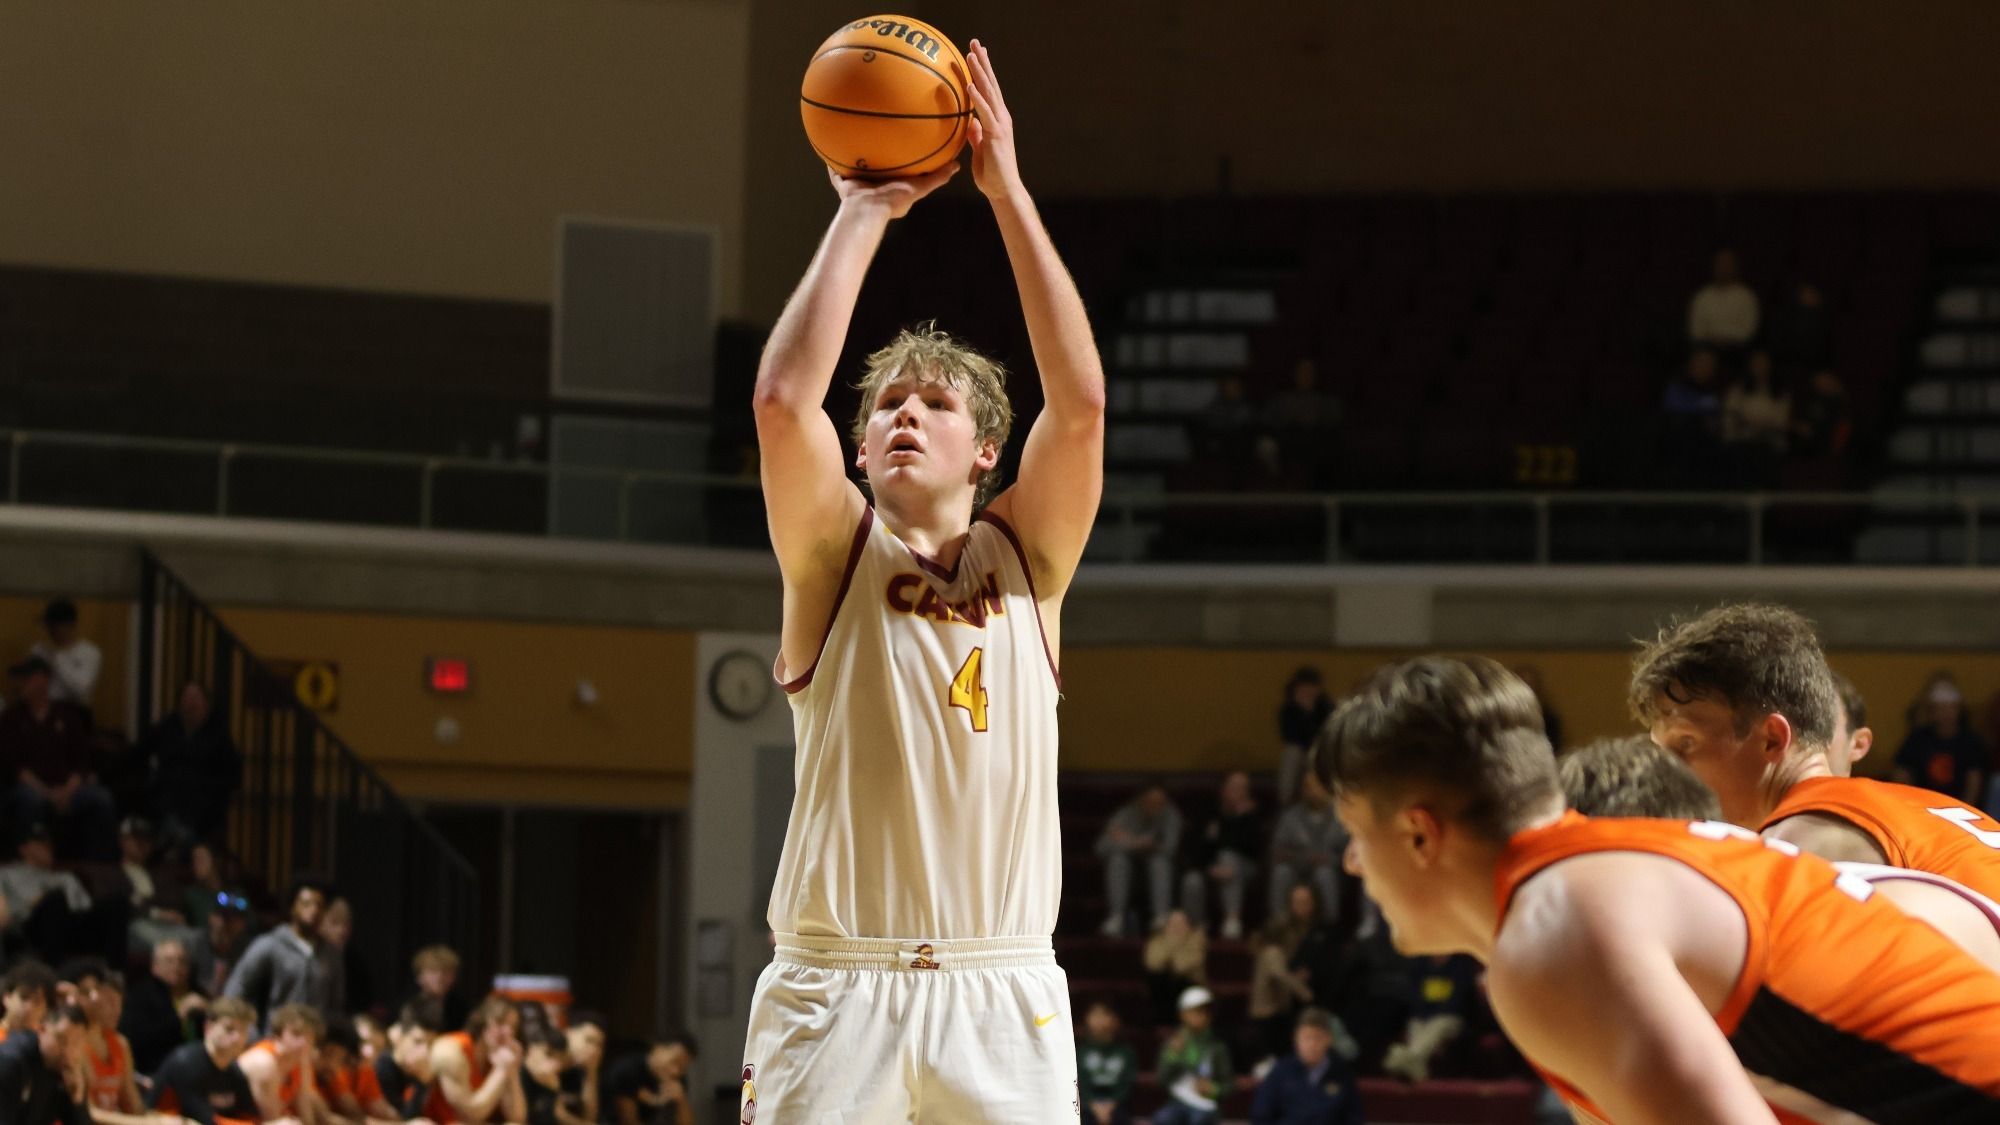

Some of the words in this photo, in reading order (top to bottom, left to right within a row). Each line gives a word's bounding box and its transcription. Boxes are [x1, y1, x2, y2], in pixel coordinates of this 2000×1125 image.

[832, 19, 942, 63] Wilso
[886, 569, 1006, 630] CAVN
[949, 646, 988, 732] 4
